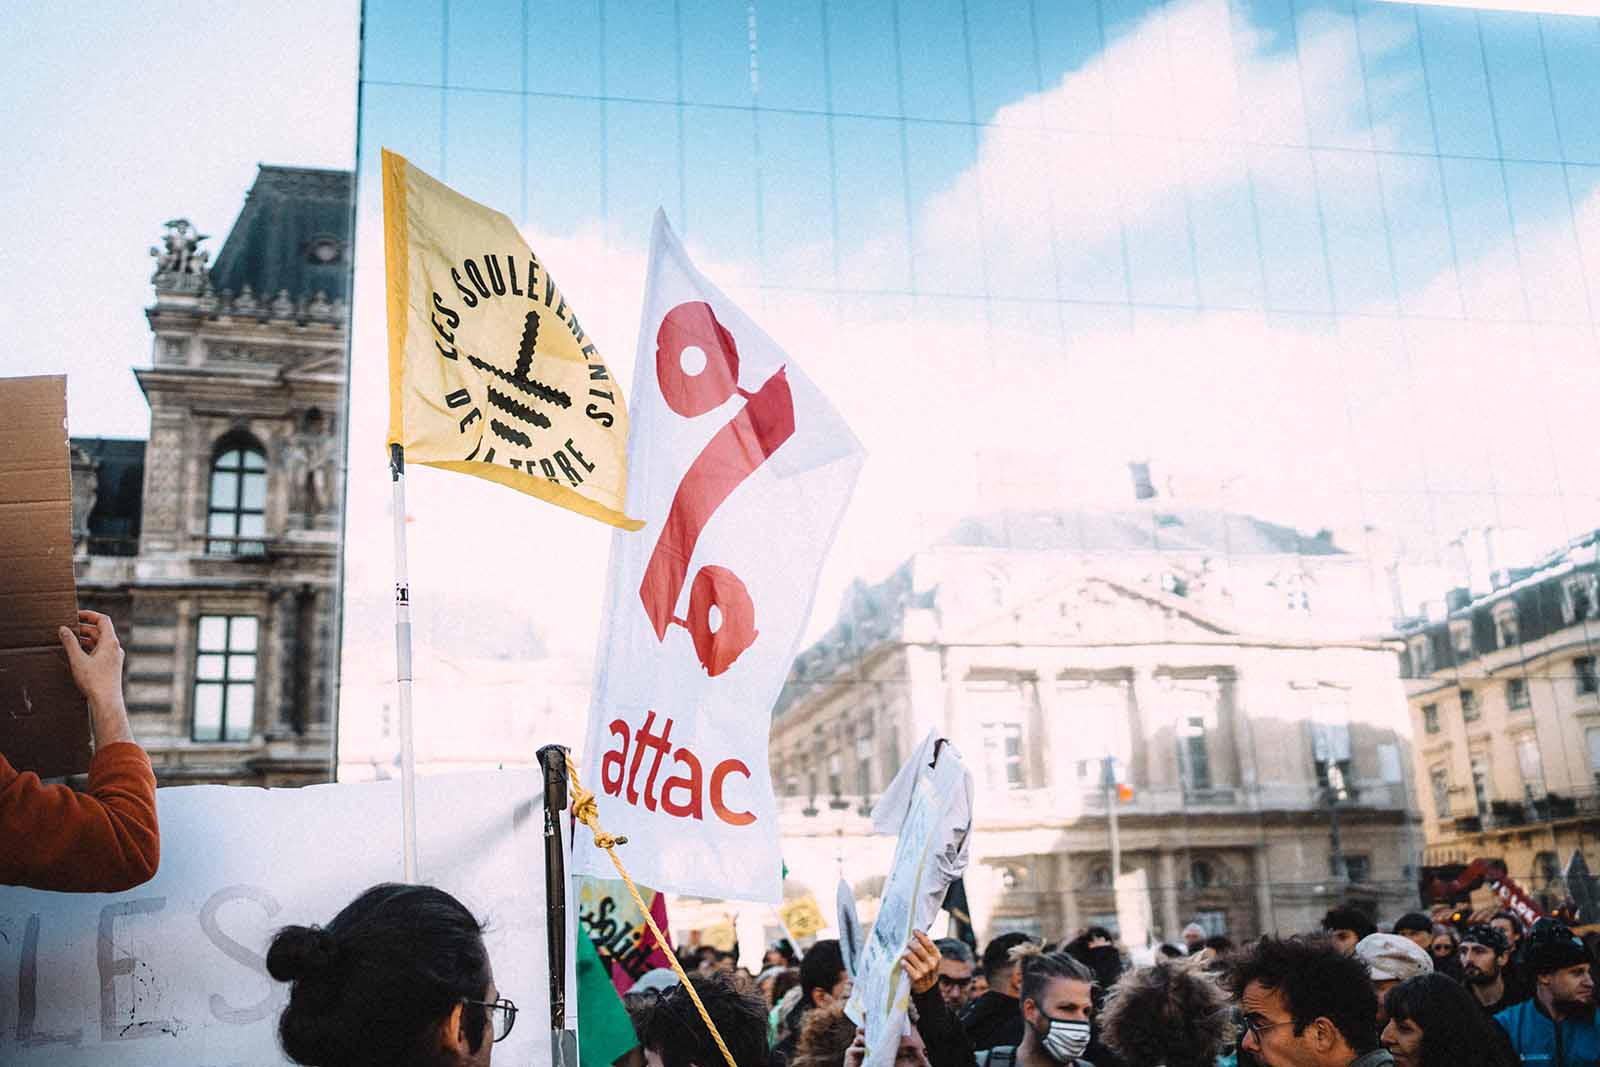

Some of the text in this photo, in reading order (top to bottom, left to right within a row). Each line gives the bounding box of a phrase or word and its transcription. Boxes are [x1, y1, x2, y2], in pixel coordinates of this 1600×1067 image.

[431, 252, 616, 428] LES SOULÈVEMENTS
[445, 388, 482, 434] DE
[601, 710, 758, 826] attac
